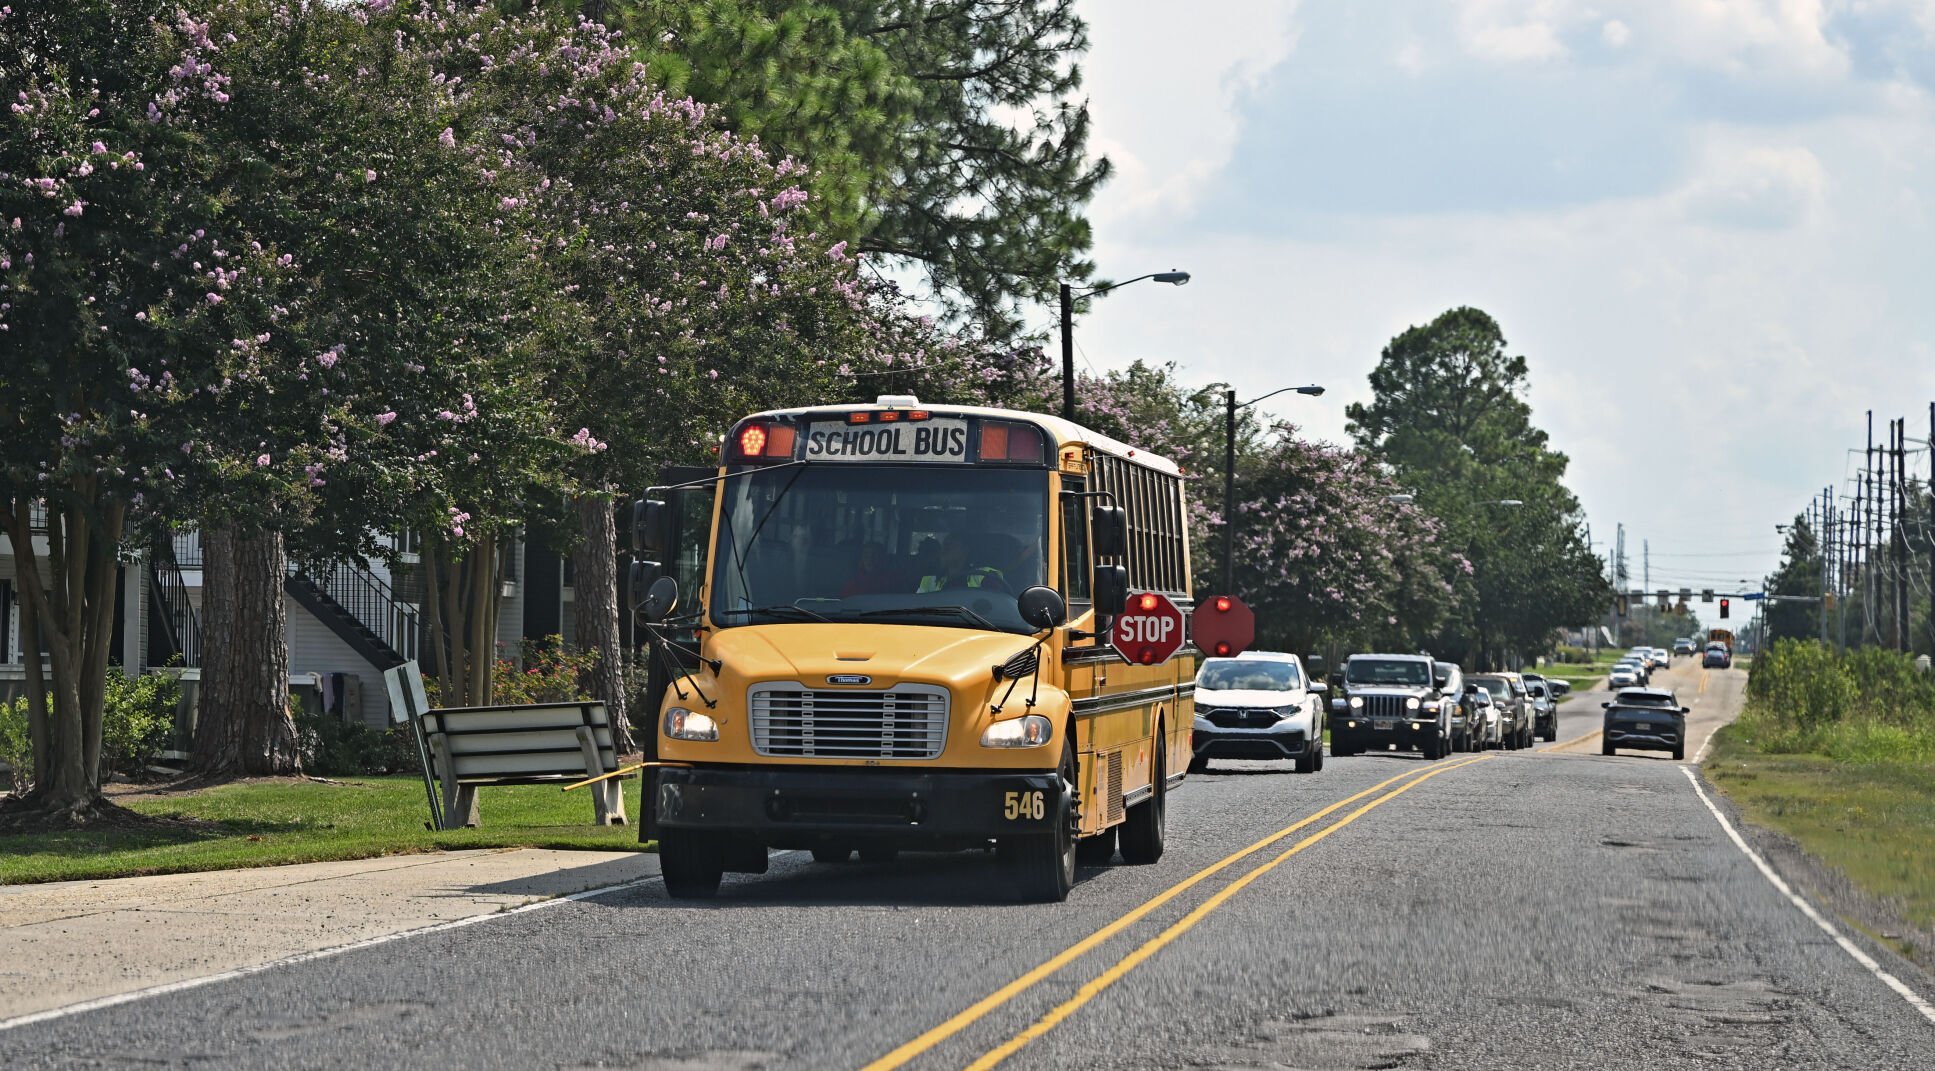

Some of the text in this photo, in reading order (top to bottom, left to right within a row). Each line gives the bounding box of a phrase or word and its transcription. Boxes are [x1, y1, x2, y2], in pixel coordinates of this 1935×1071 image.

[808, 427, 965, 456] SCHOOL BUS
[1120, 615, 1175, 643] STOP
[1004, 791, 1044, 820] 546
